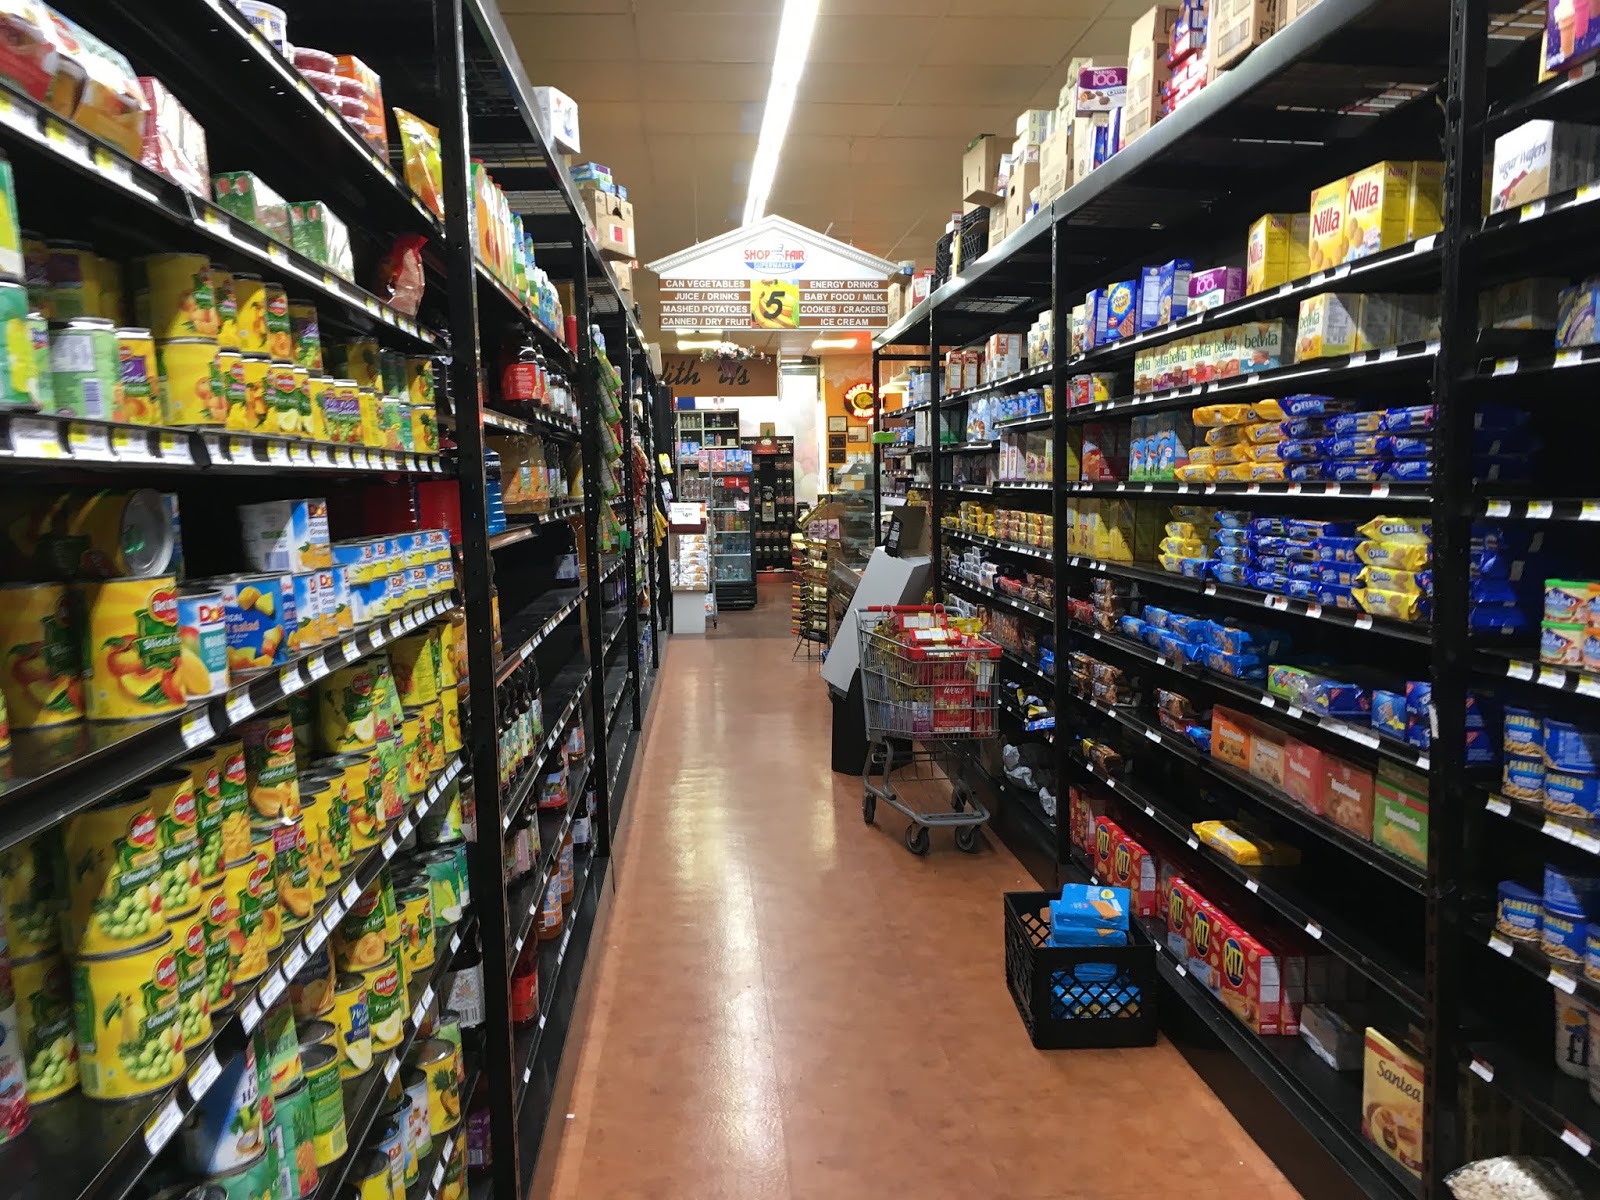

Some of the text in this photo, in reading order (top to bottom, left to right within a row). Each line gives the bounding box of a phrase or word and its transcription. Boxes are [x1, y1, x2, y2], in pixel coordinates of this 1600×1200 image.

[1093, 74, 1118, 86] 100
[1349, 181, 1379, 214] Nilla
[1312, 207, 1340, 238] Nilla
[744, 249, 805, 261] SHOP FAIR
[666, 280, 745, 288] CAN VEGETABLES
[1196, 279, 1213, 294] 100
[831, 293, 855, 301] FOOD
[863, 293, 883, 301] MILK
[663, 305, 748, 313] MASHED POTATOES
[763, 291, 785, 319] 5
[843, 306, 886, 314] CRACKERS
[662, 318, 697, 326] CANNED
[705, 318, 722, 326] DRY
[724, 318, 749, 326] FRUIT
[1244, 330, 1278, 348] belvita
[1214, 339, 1237, 353] belvita
[1291, 400, 1321, 412] OREO
[1335, 417, 1354, 430] OREO
[1333, 440, 1352, 452] OREO
[1336, 466, 1354, 478] OREO
[1400, 462, 1420, 473] OREO
[1380, 525, 1417, 534] OREO
[1096, 828, 1110, 855] RITZ
[1114, 849, 1130, 876] RITZ
[1170, 895, 1184, 922] RITZ
[1193, 919, 1210, 948] RITZ
[1224, 944, 1244, 978] RITZ
[1377, 1060, 1421, 1102] Santea
